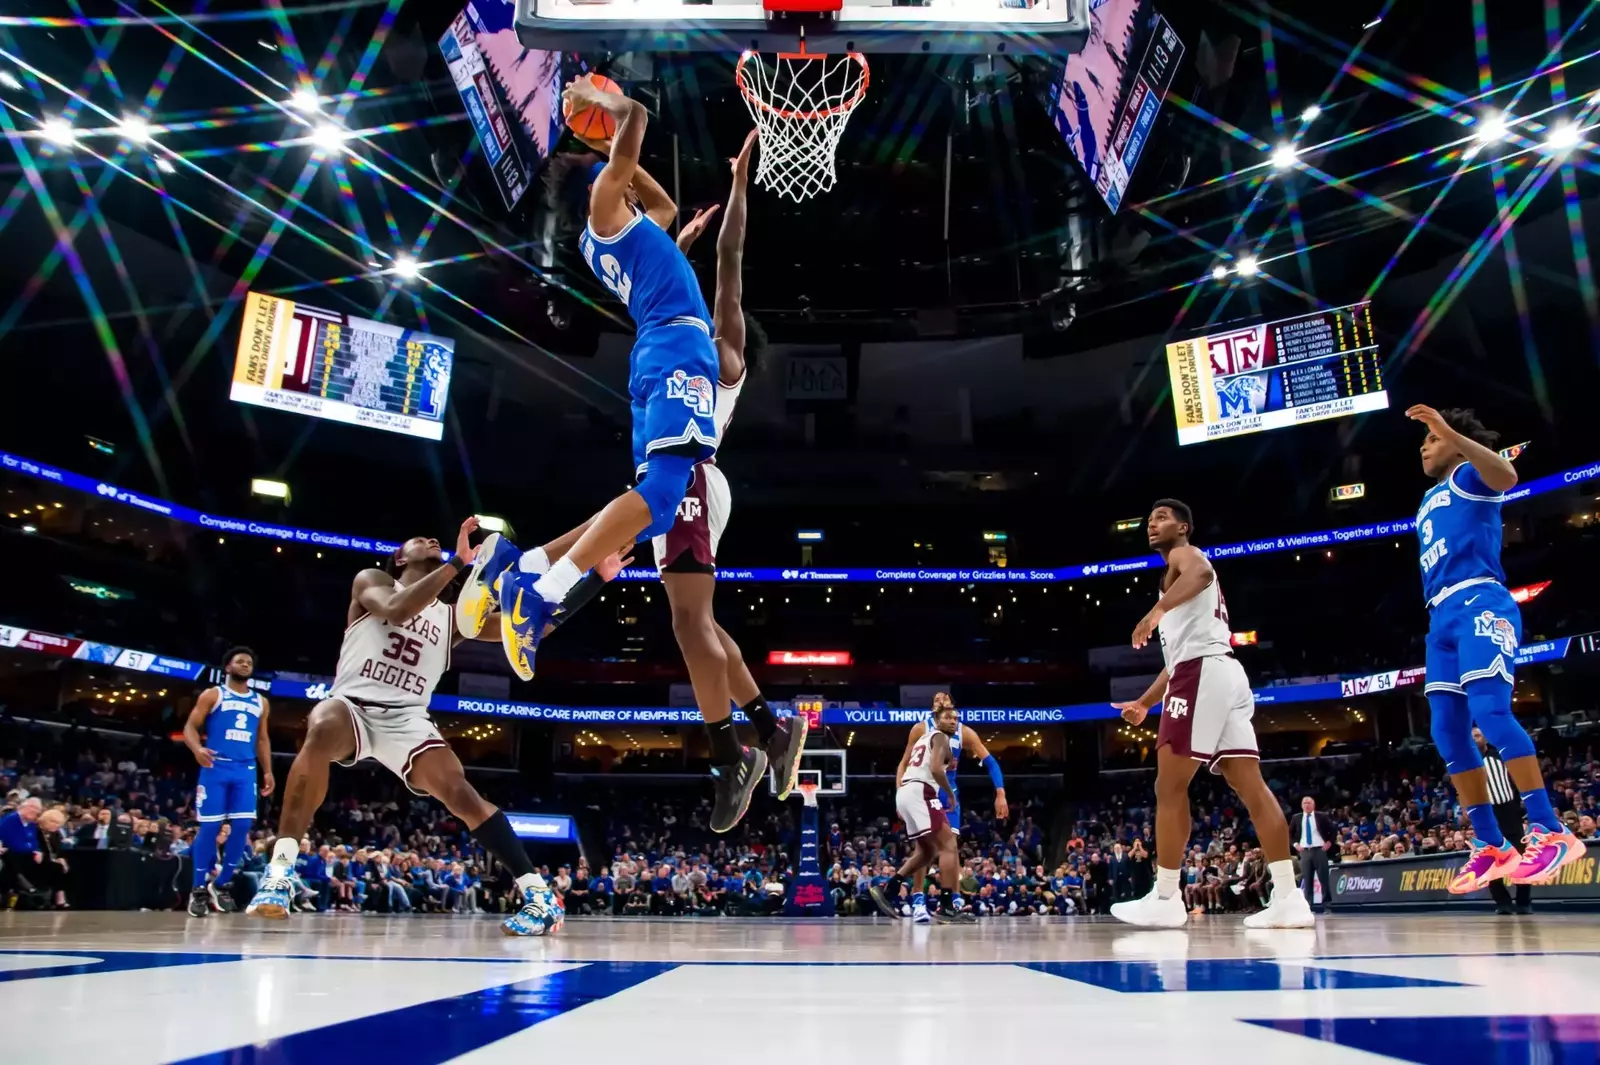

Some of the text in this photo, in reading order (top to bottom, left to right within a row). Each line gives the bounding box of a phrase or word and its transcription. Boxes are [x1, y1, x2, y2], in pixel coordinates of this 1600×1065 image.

[1147, 44, 1169, 85] 11:13
[501, 155, 519, 188] 11:13
[246, 297, 269, 382] FANS DON'T LET
[256, 361, 268, 386] FANS
[1176, 345, 1196, 424] FANS DON'T LET
[1186, 342, 1204, 424] FANS DRIVE DRUNK
[1296, 399, 1354, 415] FANS DON'T LET
[1207, 416, 1262, 431] FANS DON'T LET
[2, 454, 19, 467] for
[21, 461, 39, 474] the
[199, 514, 246, 531] Complete
[248, 523, 294, 539] Coverage
[296, 529, 309, 540] for
[311, 532, 349, 547] Grizzlies
[351, 538, 371, 549] fans.
[1214, 545, 1246, 557] Dental,
[1247, 541, 1275, 552] Vision
[1277, 538, 1285, 548] &
[1285, 533, 1332, 547] Wellness.
[1332, 528, 1374, 541] Together
[1376, 524, 1390, 534] for
[1392, 522, 1409, 532] the
[1422, 518, 1433, 545] 3
[620, 570, 628, 578] &
[721, 570, 735, 579] the
[737, 571, 755, 579] win.
[800, 571, 849, 580] of Tennessee
[876, 570, 1056, 581] Complete Coverage for Grizzlies fans. Score.
[1100, 561, 1148, 573] of Tennessee
[382, 614, 441, 646] XAS
[128, 652, 143, 668] 57
[382, 631, 423, 667] 35
[359, 658, 427, 696] AGGIES
[1378, 674, 1391, 688] 54
[234, 713, 248, 729] 2
[457, 699, 704, 721] PROUD HEARING CARE PARTNER OF MEMPHIS TIGE
[845, 710, 886, 722] YOU'LL
[967, 710, 1006, 721] BETTER
[1008, 709, 1065, 721] HEARING.
[1346, 876, 1384, 892] RJYoung
[1400, 870, 1417, 892] THE
